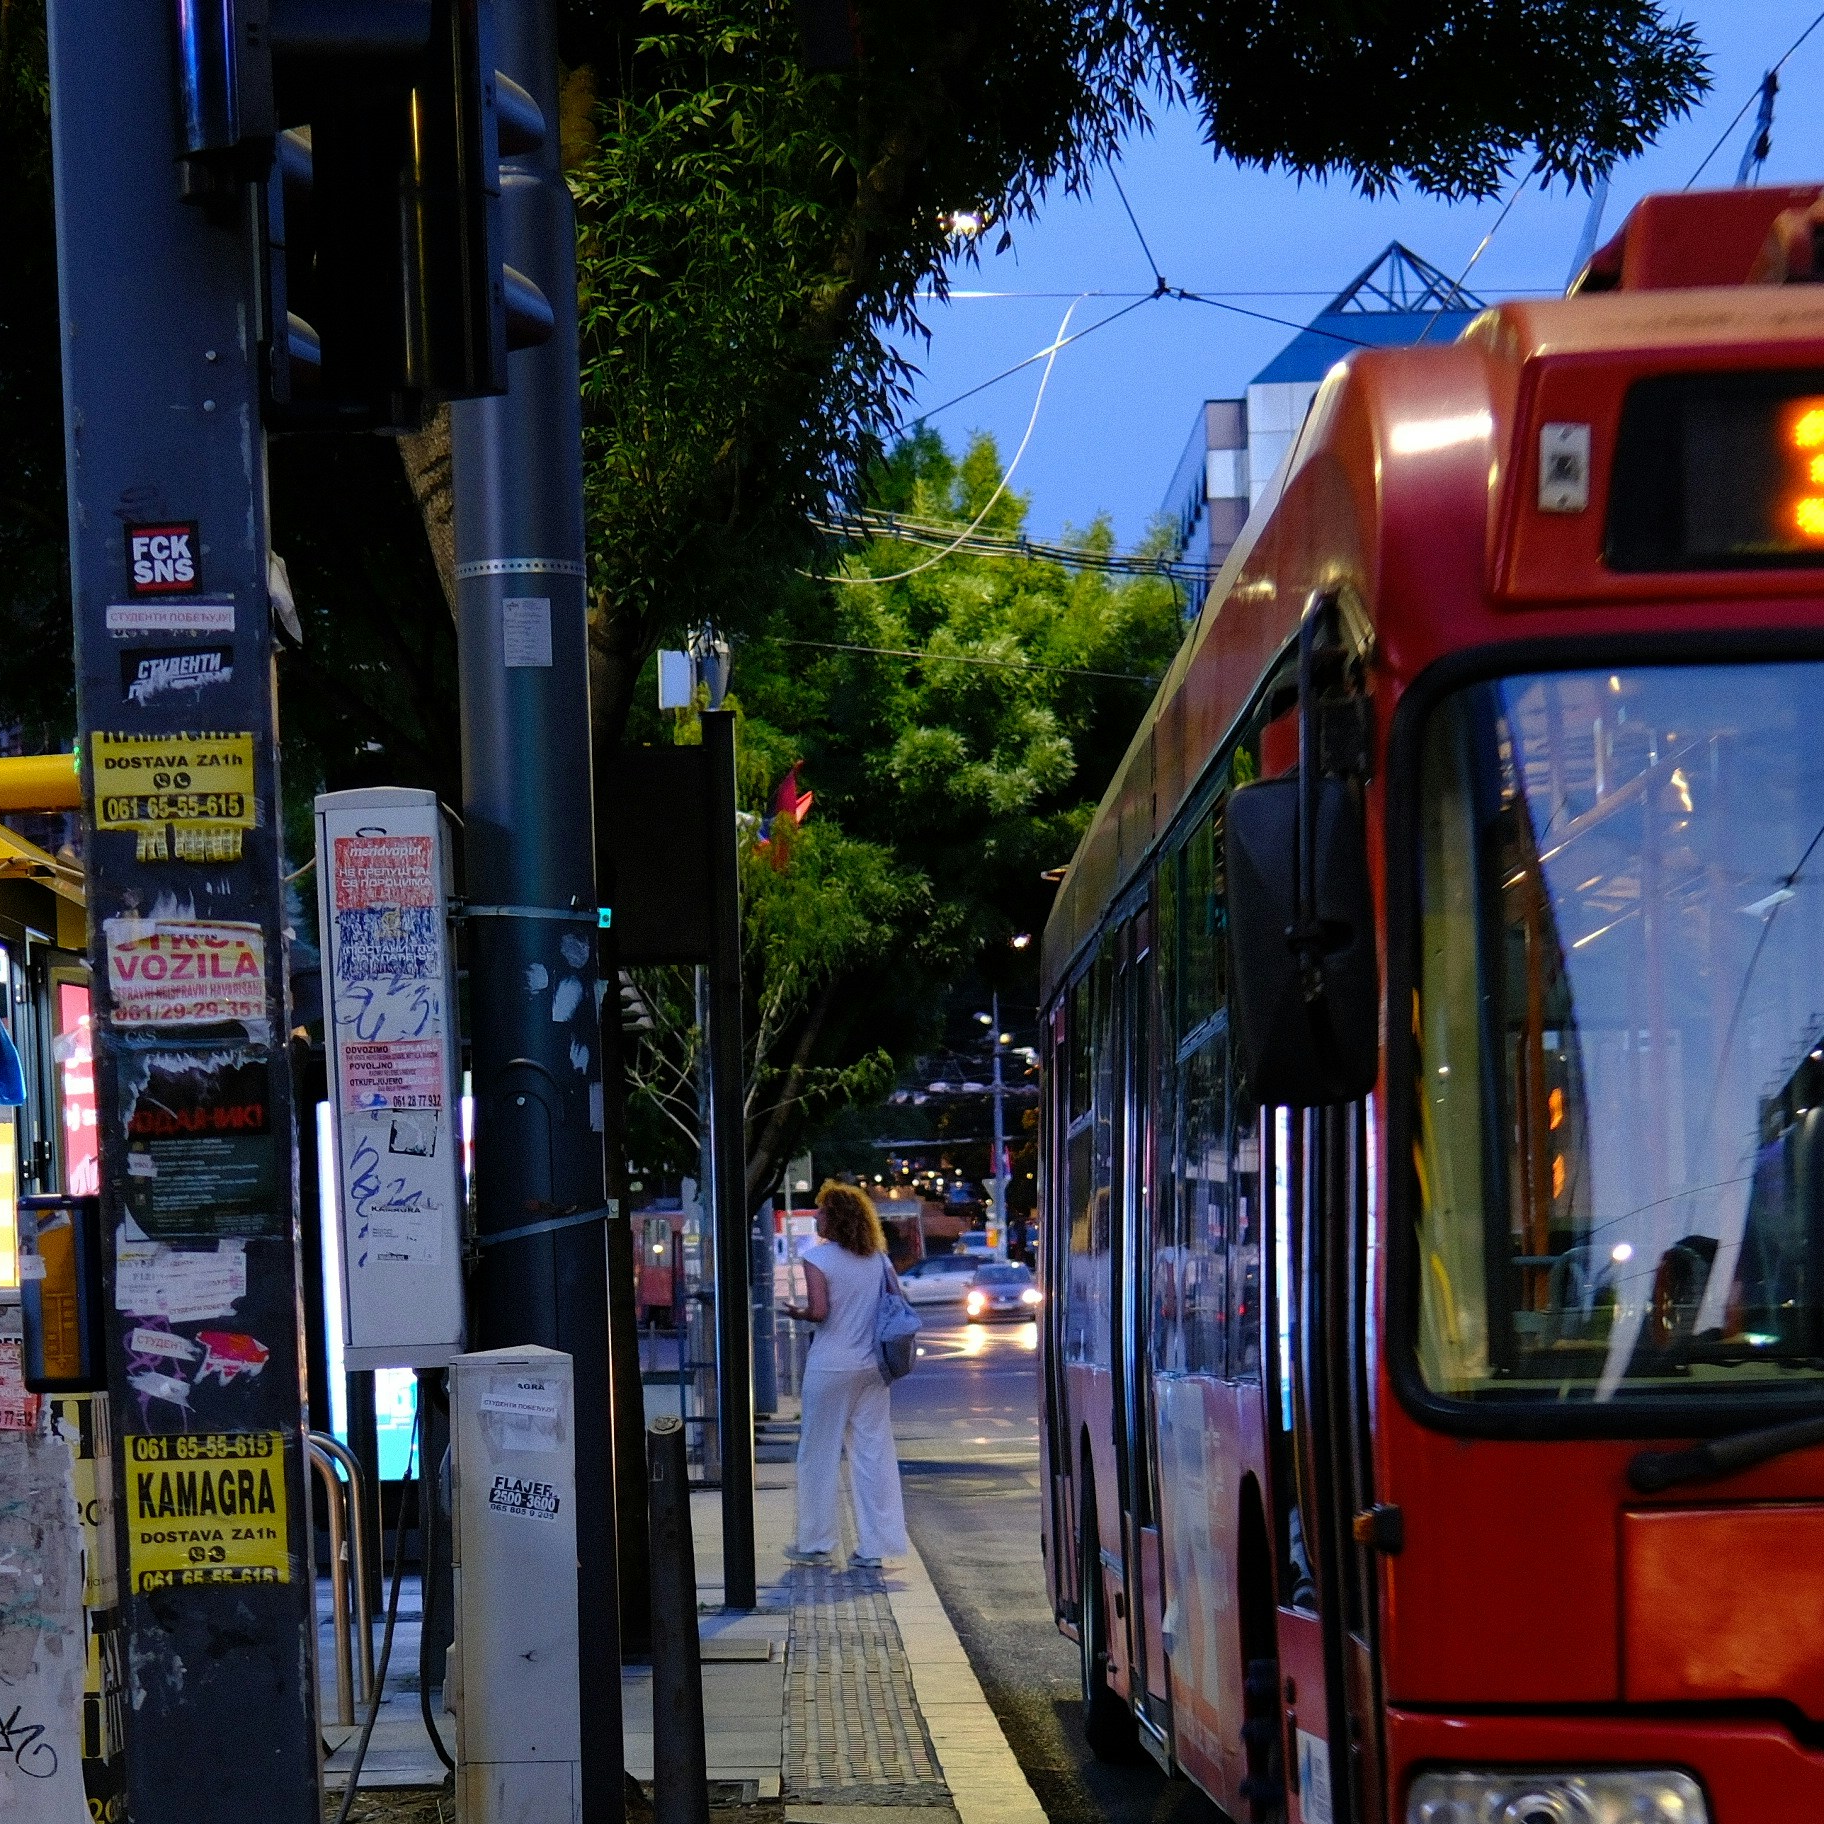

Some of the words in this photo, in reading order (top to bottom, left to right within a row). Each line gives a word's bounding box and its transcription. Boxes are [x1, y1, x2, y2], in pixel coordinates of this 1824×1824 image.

[132, 535, 190, 560] FCK
[134, 559, 194, 583] SNS
[138, 652, 221, 679] СТУДЕНТИ
[105, 755, 188, 769] DOSTAVA
[108, 797, 139, 820] 061
[114, 952, 259, 981] VOZILA
[137, 1441, 167, 1460] 061
[137, 1470, 275, 1519] KAMAGRA
[141, 1528, 223, 1544] DOSTAVA
